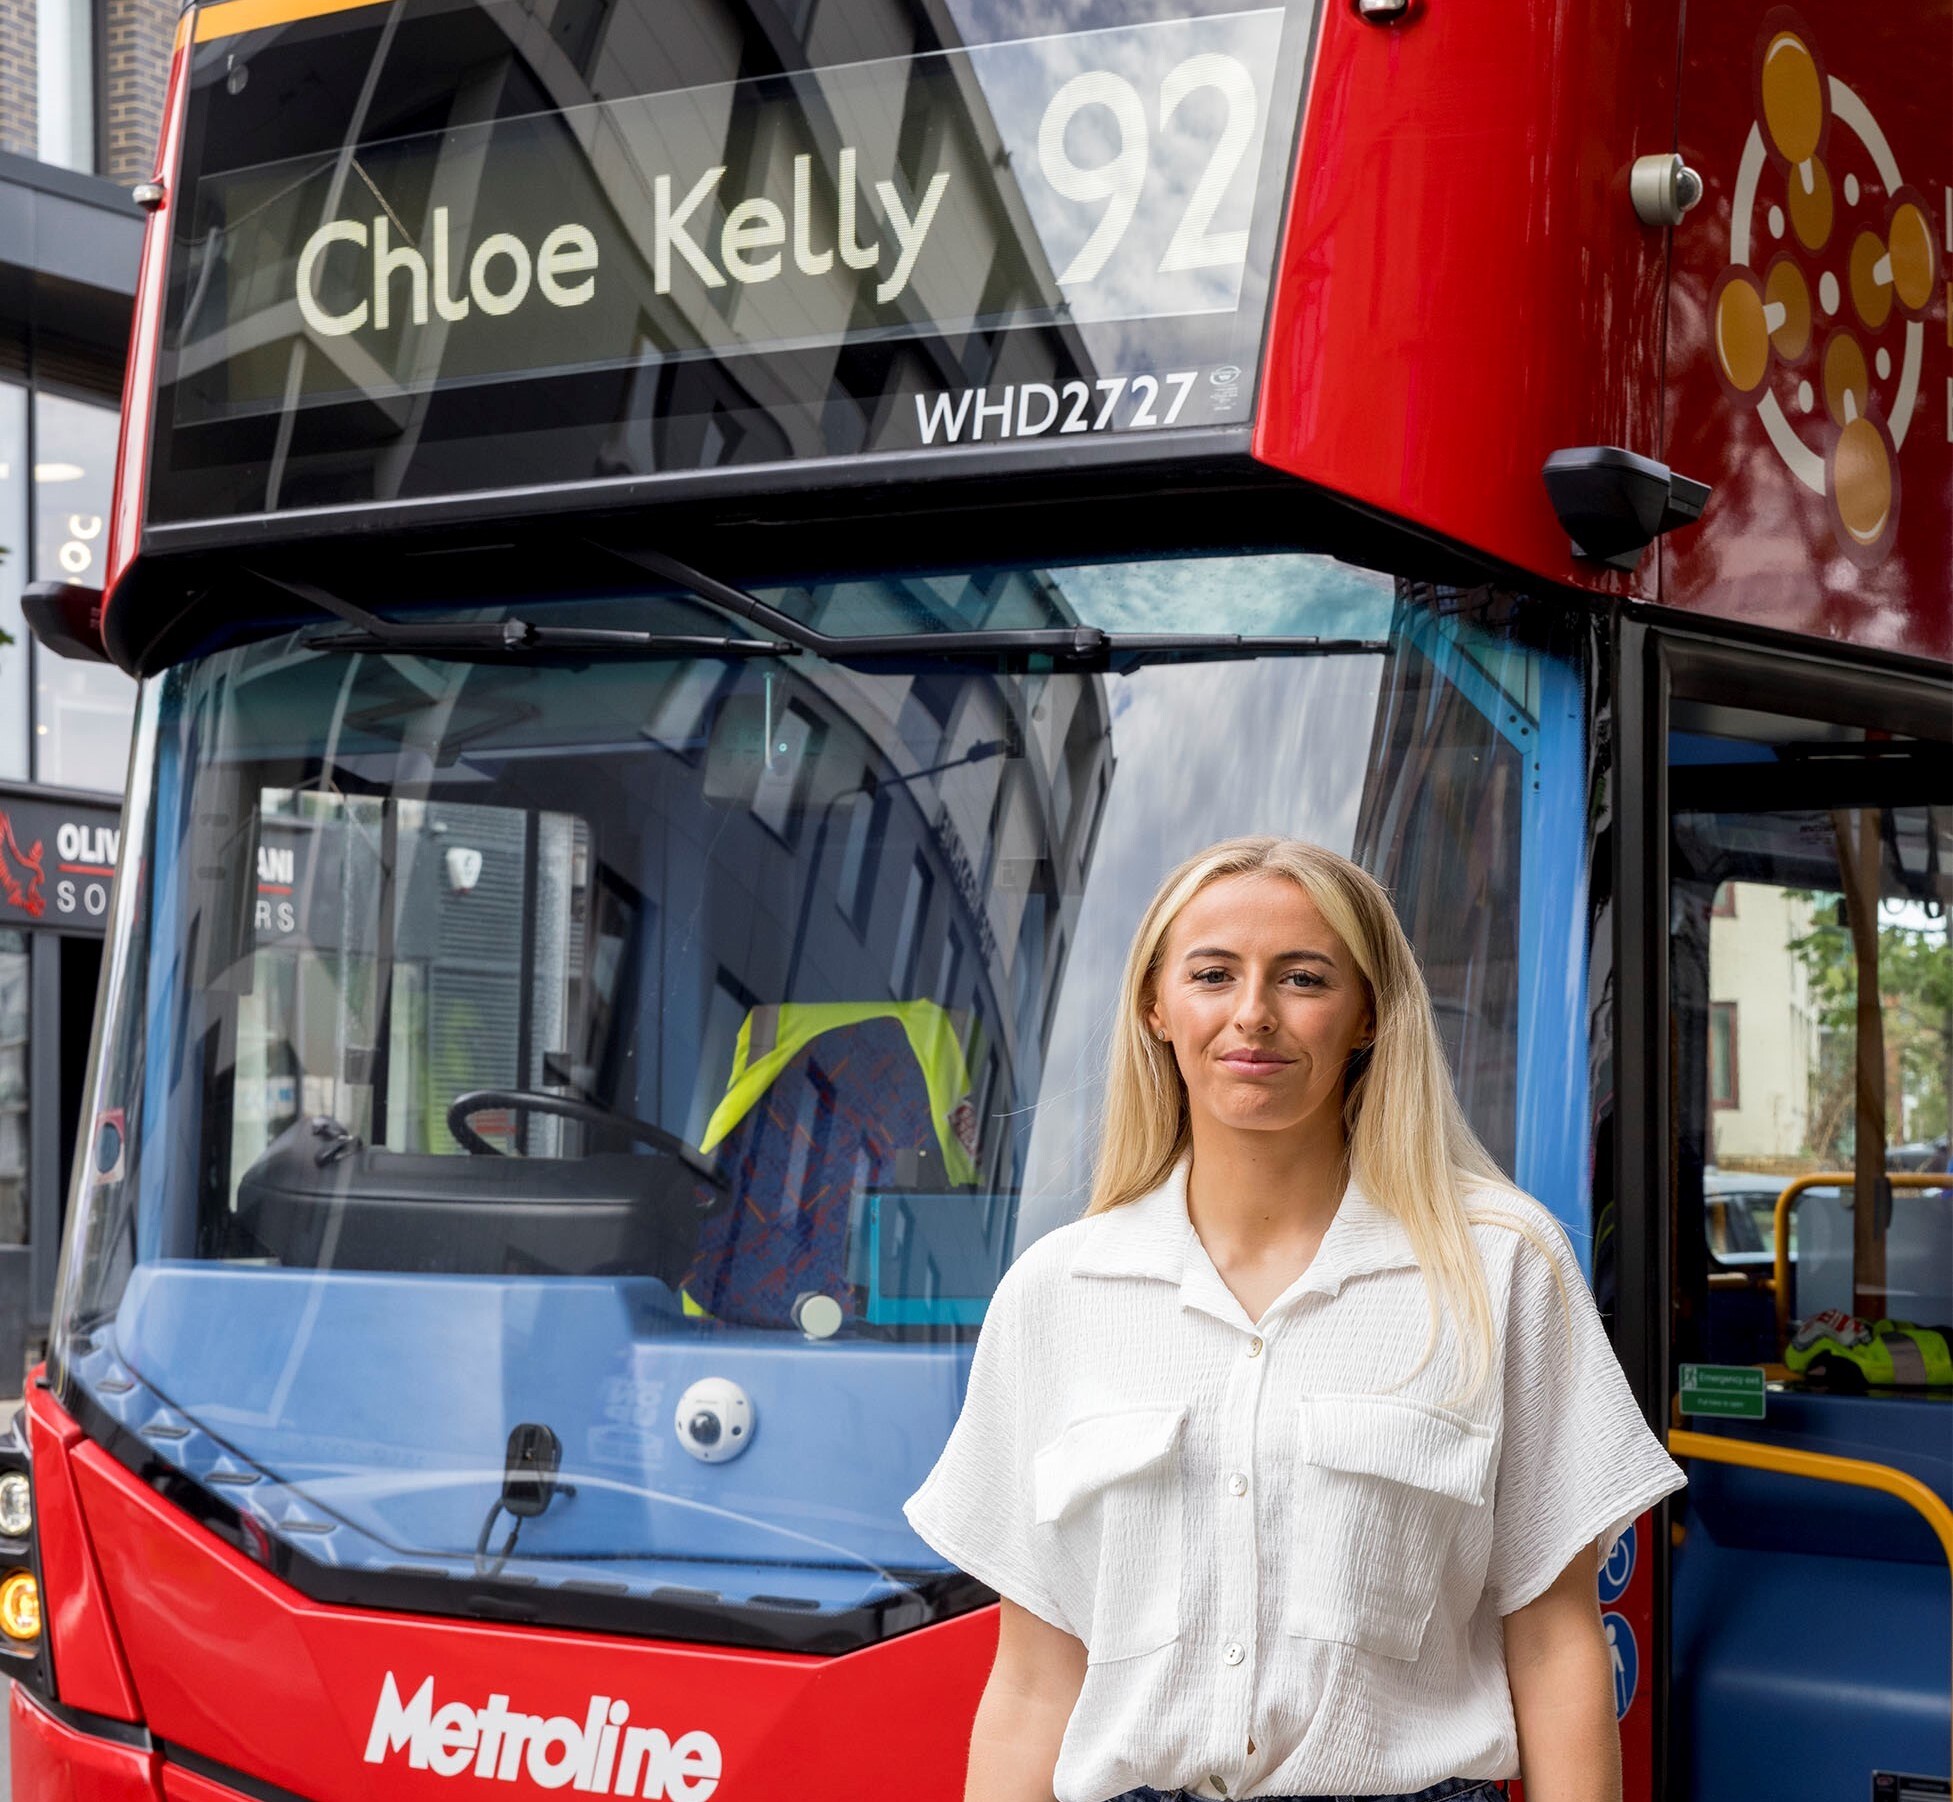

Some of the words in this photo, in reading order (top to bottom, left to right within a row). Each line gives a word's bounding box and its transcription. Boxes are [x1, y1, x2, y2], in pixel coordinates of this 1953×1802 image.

[296, 206, 598, 337] Chloe
[654, 148, 950, 304] Kelly
[1038, 53, 1256, 286] 92
[914, 371, 1198, 444] WHD2727
[363, 1670, 722, 1802] Metroline
